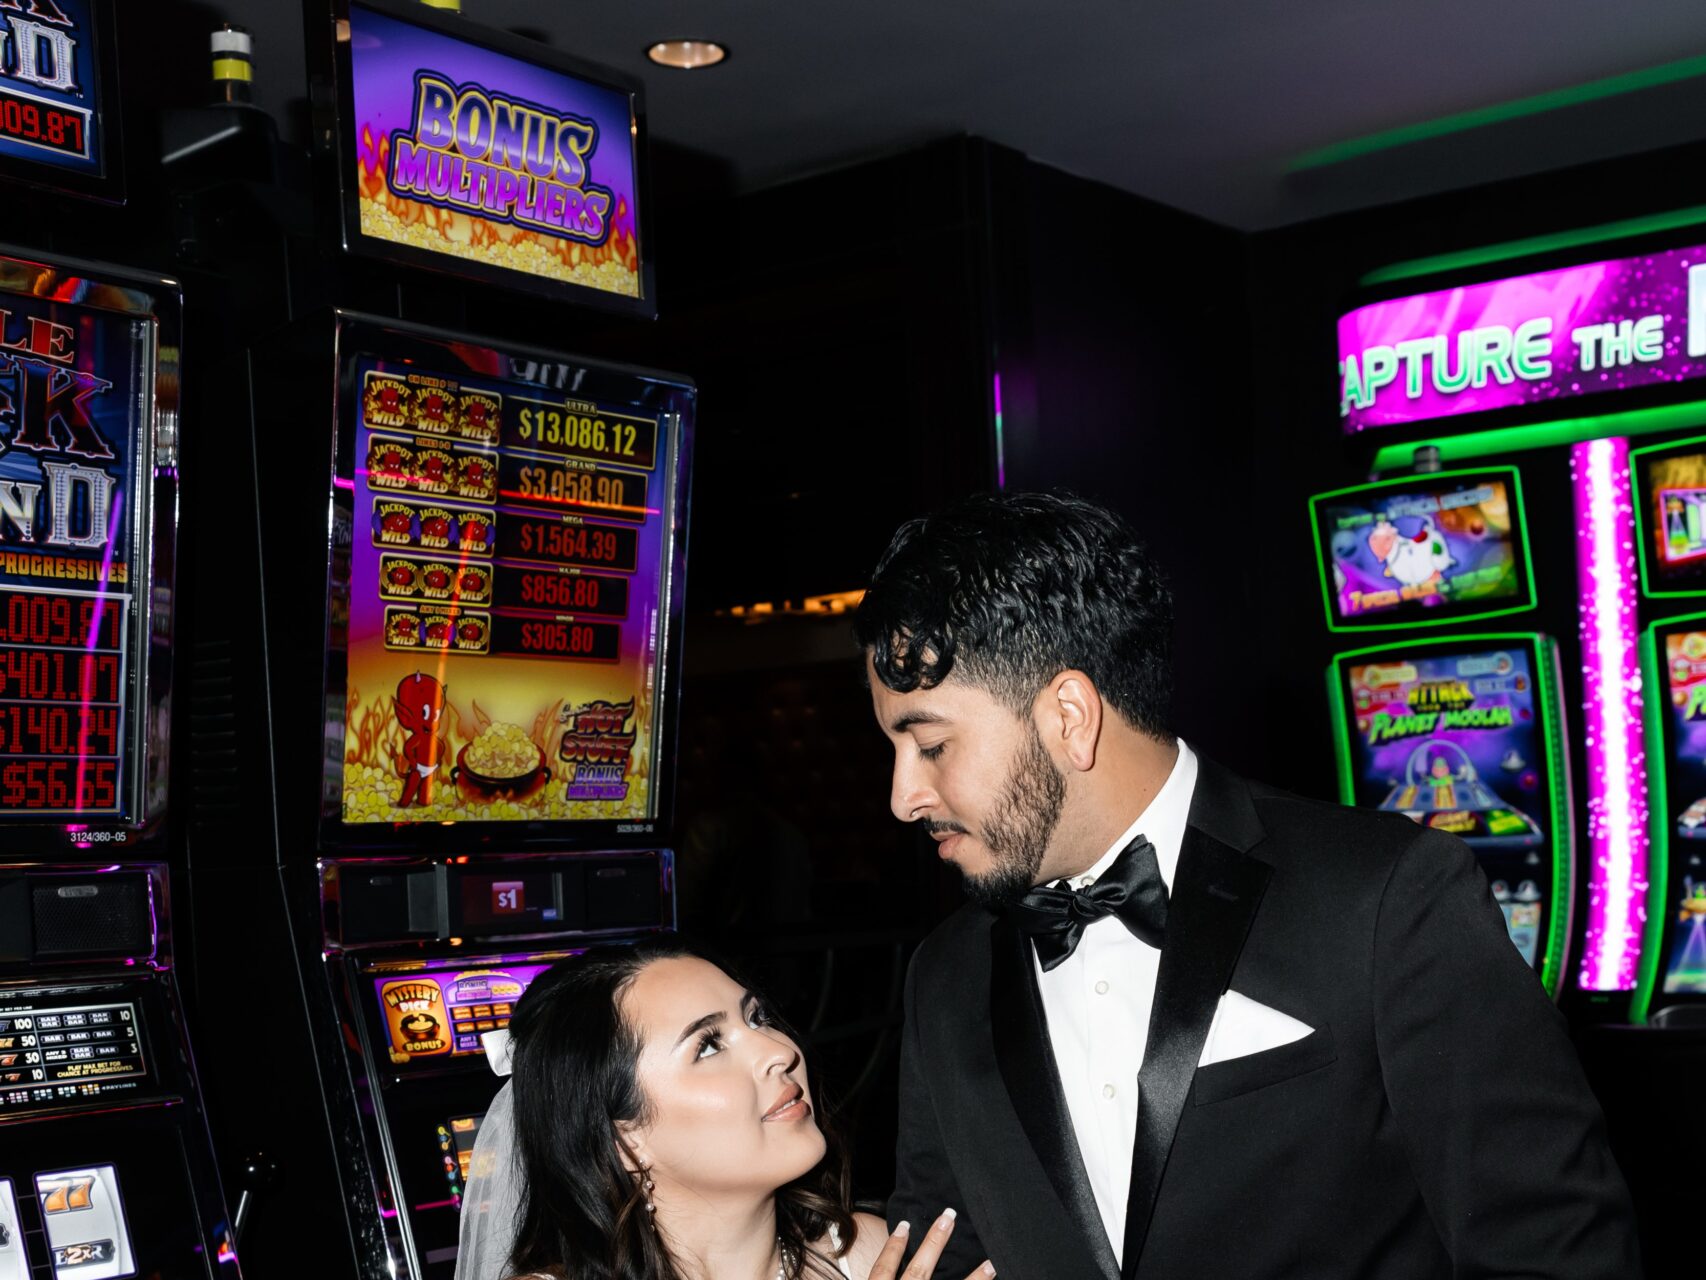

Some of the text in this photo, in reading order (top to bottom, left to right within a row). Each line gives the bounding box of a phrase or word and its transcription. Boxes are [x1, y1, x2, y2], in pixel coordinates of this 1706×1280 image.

[415, 77, 594, 187] BONUS
[394, 138, 610, 239] MULTIPLIERS
[1339, 314, 1665, 417] APTURE THE
[370, 380, 497, 412] JACKPOT JACKPOT JACKPOT
[566, 400, 597, 414] ULTRA
[372, 412, 492, 440] WILD WILD WILD
[519, 408, 637, 457] $13,086.12
[374, 444, 494, 471] JACKPOT JACKPOT JACKPOT
[565, 459, 596, 472] GRAND
[375, 475, 489, 499] WILD WILD WILD
[380, 503, 491, 527] JACKPOT JACKPOT JACKPOT
[562, 515, 584, 525] MEGA
[381, 530, 487, 552] WILD WILD WILD
[520, 523, 617, 561] $1,564.39
[387, 584, 484, 602] WILD WILD WILD
[521, 574, 599, 608] $856.80
[392, 635, 482, 650] WILD WILD WILD
[521, 623, 594, 653] $305.80
[576, 703, 634, 733] HOT
[1368, 706, 1514, 745] PLANET MOOLAH
[561, 731, 636, 763] STUFF
[575, 764, 626, 784] BONUS
[499, 888, 517, 908] $1
[384, 982, 441, 1008] MYSTERY
[399, 1000, 431, 1012] PICK
[14, 1018, 32, 1029] 100
[120, 1010, 130, 1020] 10
[21, 1035, 36, 1046] 50
[127, 1026, 134, 1037] 5
[130, 1043, 138, 1053] 3
[405, 1040, 443, 1051] BONUS
[25, 1052, 40, 1064] 30
[31, 1069, 43, 1080] 10
